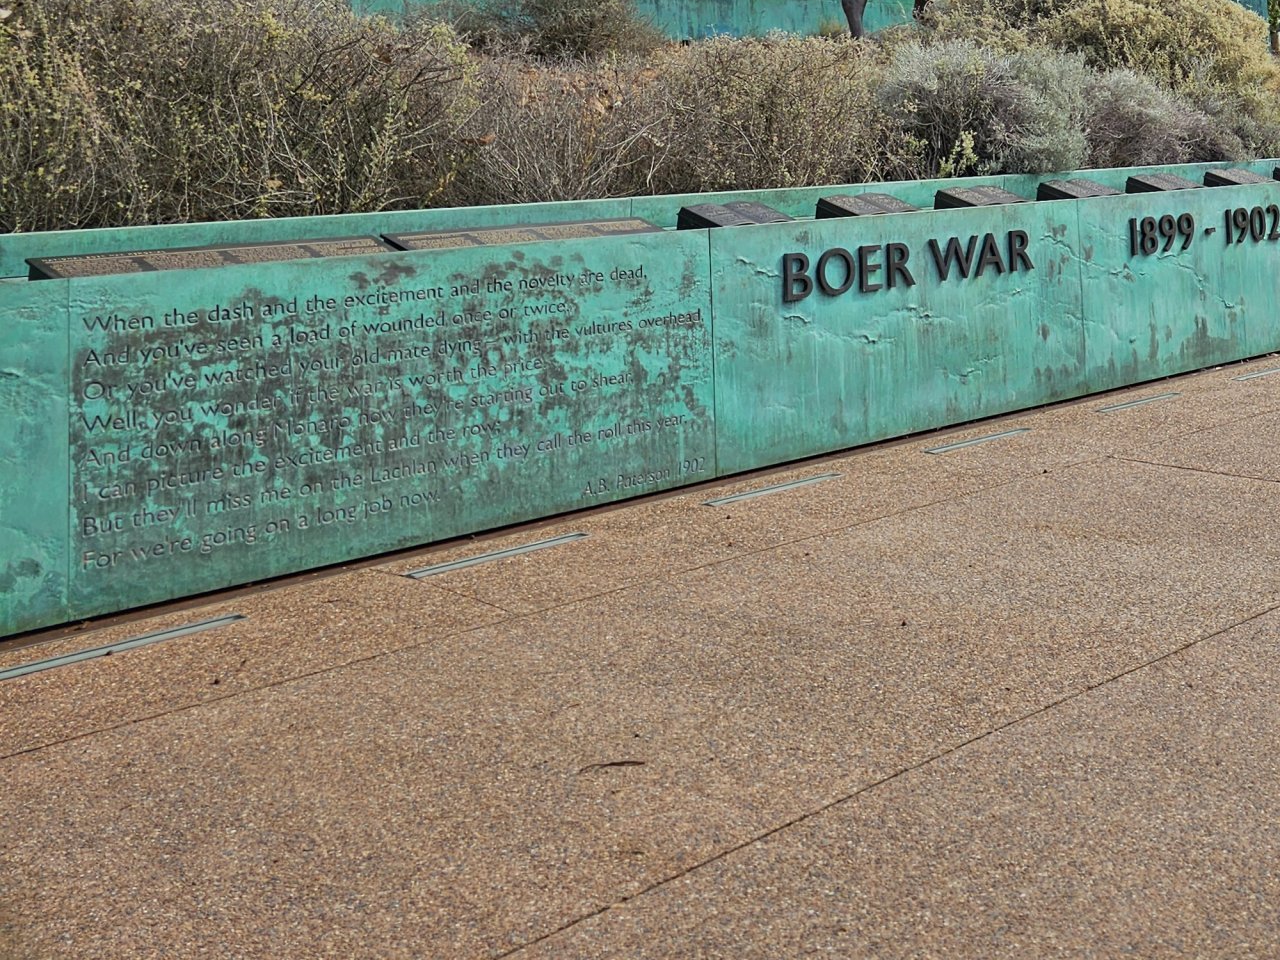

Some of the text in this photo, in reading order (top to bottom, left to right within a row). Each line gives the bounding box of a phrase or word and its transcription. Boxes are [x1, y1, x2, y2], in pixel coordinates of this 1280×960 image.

[782, 228, 1035, 304] BOER WAR
[1129, 212, 1196, 257] 1899
[83, 313, 154, 332] When
[164, 308, 199, 327] the
[207, 302, 254, 323] dash
[262, 296, 298, 318] and
[306, 294, 337, 313] the
[344, 286, 444, 308] excitement
[450, 279, 480, 297] and
[487, 278, 513, 292] the
[518, 272, 575, 290] novelty
[579, 271, 604, 284] are
[83, 345, 131, 368] And
[140, 339, 208, 365] you've
[216, 334, 263, 353] seen
[271, 333, 282, 347] a
[289, 323, 331, 345] load
[338, 320, 358, 338] of
[363, 311, 446, 335] wounded
[452, 310, 492, 326] once
[499, 306, 517, 319] or
[83, 380, 117, 401] Or
[127, 372, 198, 400] you've
[204, 358, 292, 386] watched
[300, 357, 343, 379] your
[352, 347, 380, 368] old
[387, 345, 431, 362] mate
[438, 339, 482, 358] dying
[503, 329, 538, 347] with
[545, 324, 570, 341] the
[575, 321, 633, 337] vultures
[152, 406, 193, 431] you
[201, 395, 281, 417] wonder
[289, 387, 302, 406] if
[307, 385, 340, 403] the
[347, 381, 383, 398] war
[388, 376, 401, 390] is
[408, 367, 463, 387] worth
[470, 362, 497, 379] the
[79, 444, 131, 467] And
[140, 439, 201, 459] down
[209, 429, 267, 449] along
[273, 416, 350, 439] Monaro
[358, 409, 398, 426] now
[404, 396, 464, 419] they're
[470, 386, 534, 407] starting
[539, 382, 565, 397] out
[571, 379, 587, 392] to
[82, 514, 124, 539] But
[132, 497, 197, 526] they'll
[206, 492, 252, 514] miss
[260, 486, 292, 504] me
[299, 480, 324, 496] on
[331, 471, 365, 491] the
[370, 459, 438, 485] Lachlan
[444, 451, 489, 470] when
[496, 442, 531, 461] they
[537, 432, 561, 452] call
[567, 430, 592, 446] the
[597, 422, 621, 440] roll
[627, 419, 652, 435] this
[83, 483, 89, 504] I
[99, 481, 136, 500] can
[146, 466, 224, 496] picture
[232, 458, 266, 477] the
[274, 440, 383, 470] excitement
[388, 430, 420, 451] and
[428, 424, 456, 444] the
[583, 456, 706, 497] A.B. Paterson 1902
[82, 550, 123, 572] For
[131, 536, 193, 561] we're
[201, 525, 257, 554] going
[265, 518, 290, 535] on
[298, 515, 309, 529] a
[316, 507, 356, 526] long
[364, 494, 393, 519] job
